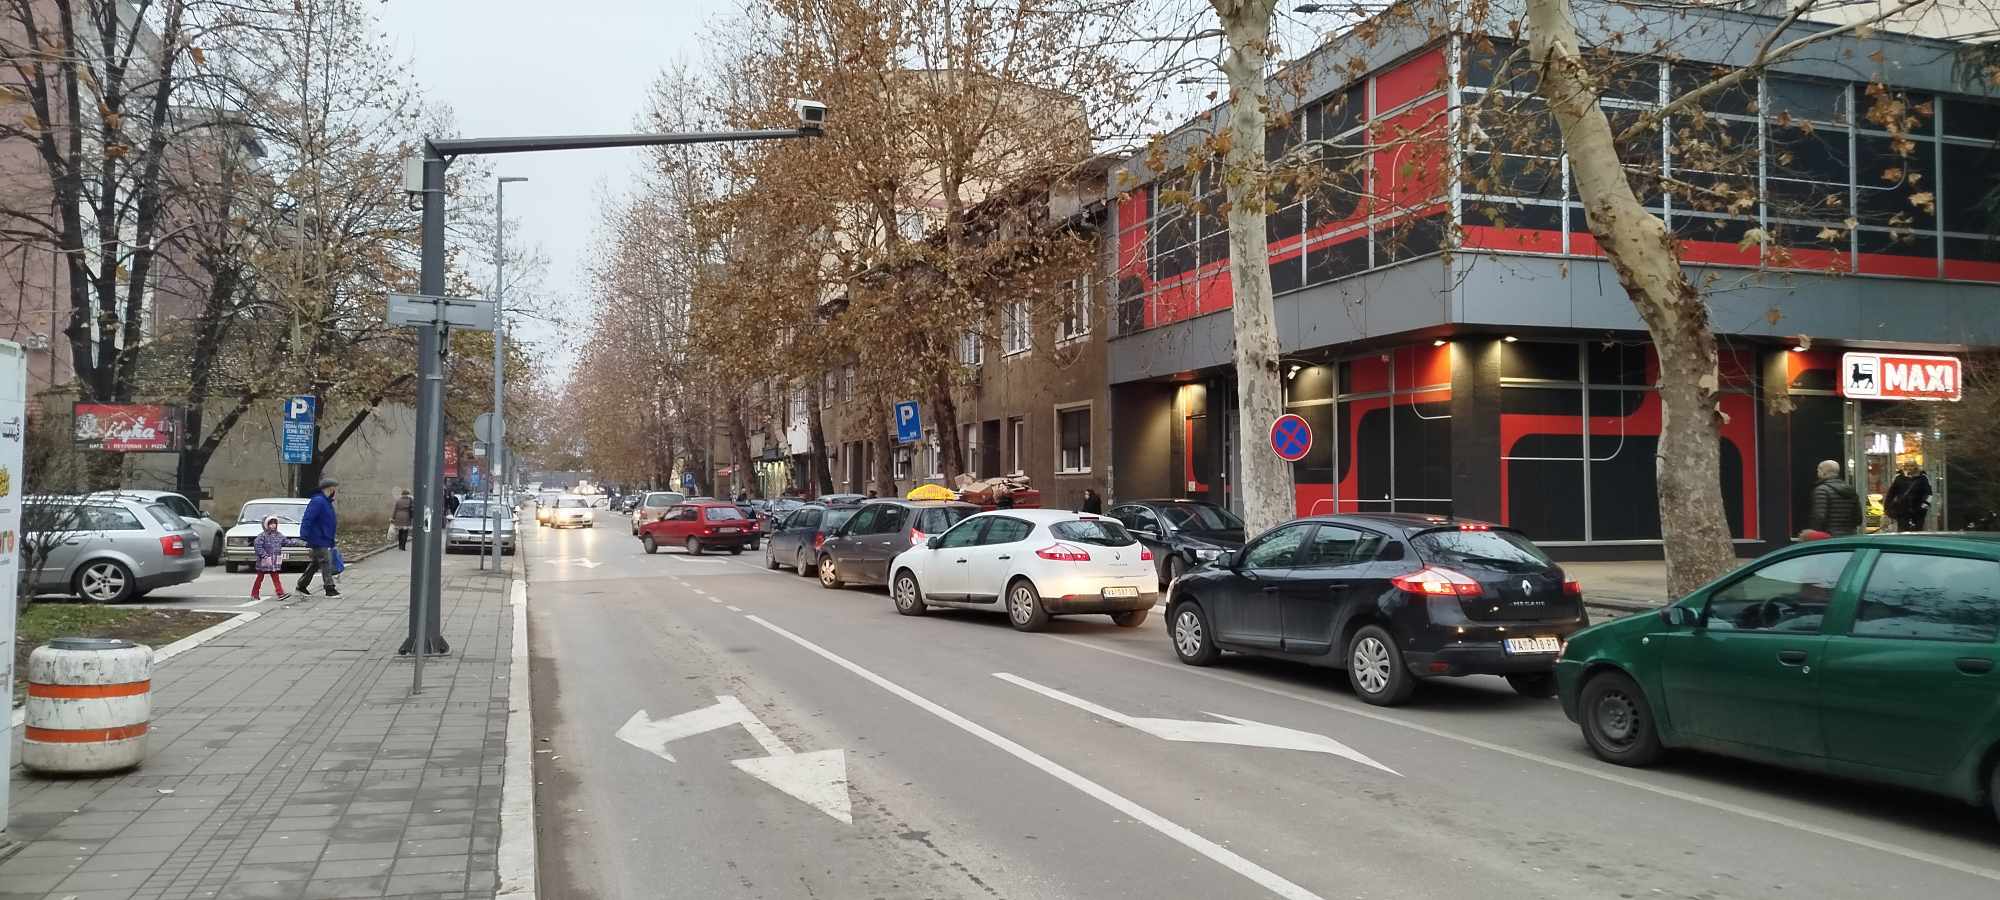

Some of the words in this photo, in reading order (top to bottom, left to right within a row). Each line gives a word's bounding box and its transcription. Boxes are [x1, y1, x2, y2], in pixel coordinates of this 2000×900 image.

[1884, 363, 1954, 393] MAXI
[290, 398, 308, 419] P
[900, 405, 914, 426] P
